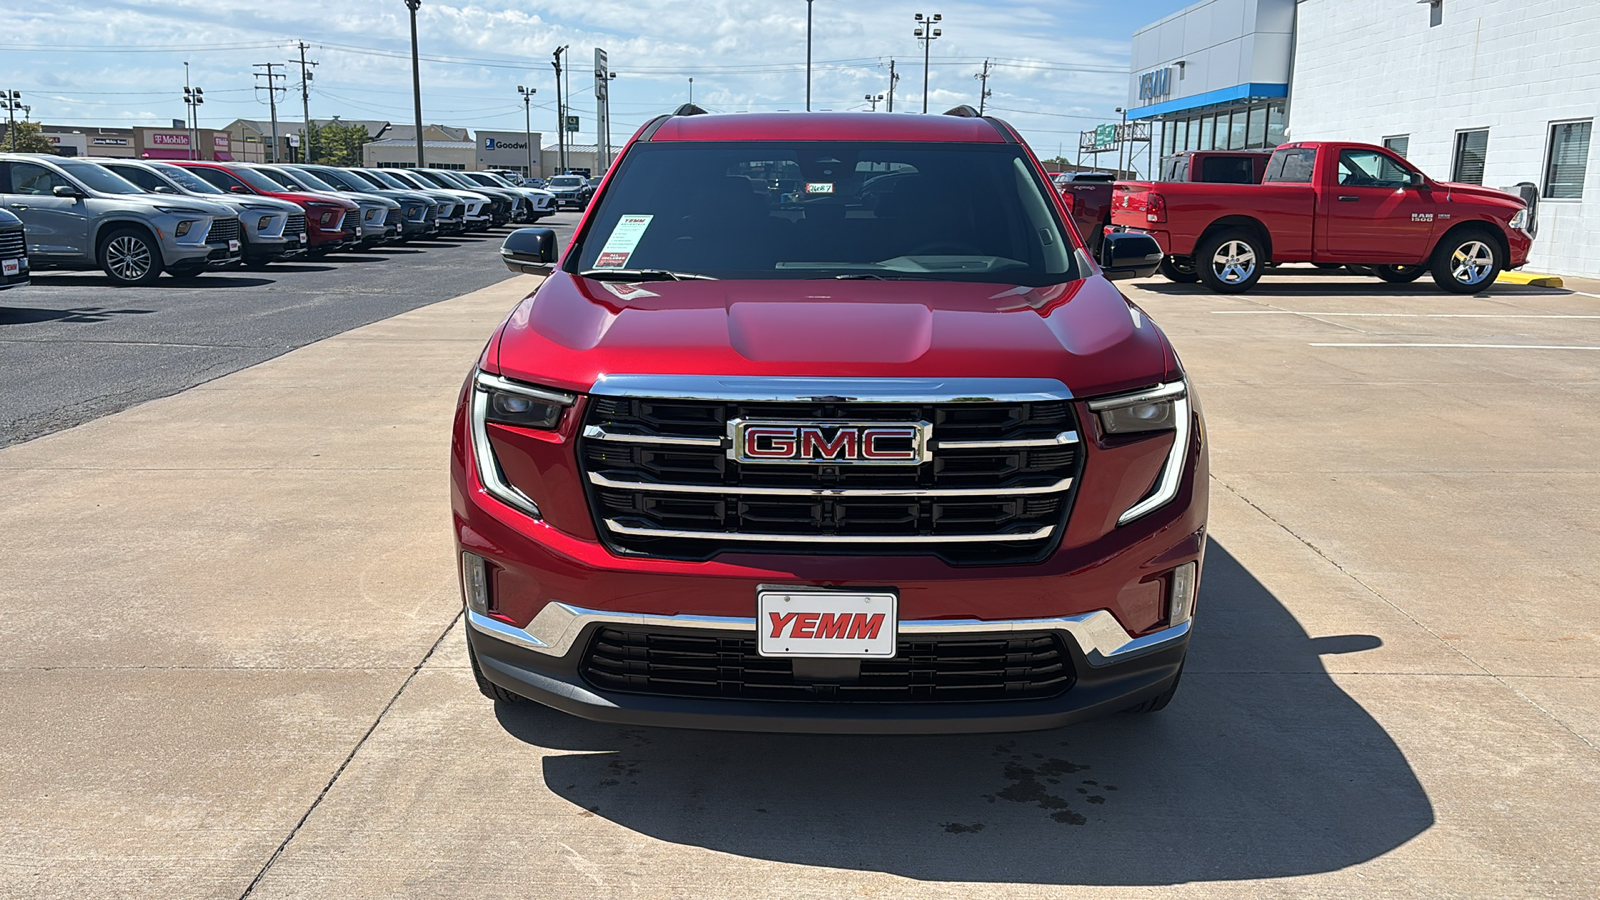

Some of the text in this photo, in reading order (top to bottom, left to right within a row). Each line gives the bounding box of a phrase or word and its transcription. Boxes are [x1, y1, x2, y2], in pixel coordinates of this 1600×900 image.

[1139, 68, 1172, 100] YEMM
[162, 136, 189, 145] Mobile
[495, 141, 528, 149] Goodwi
[745, 427, 915, 459] GMC
[768, 612, 886, 639] YEMM
